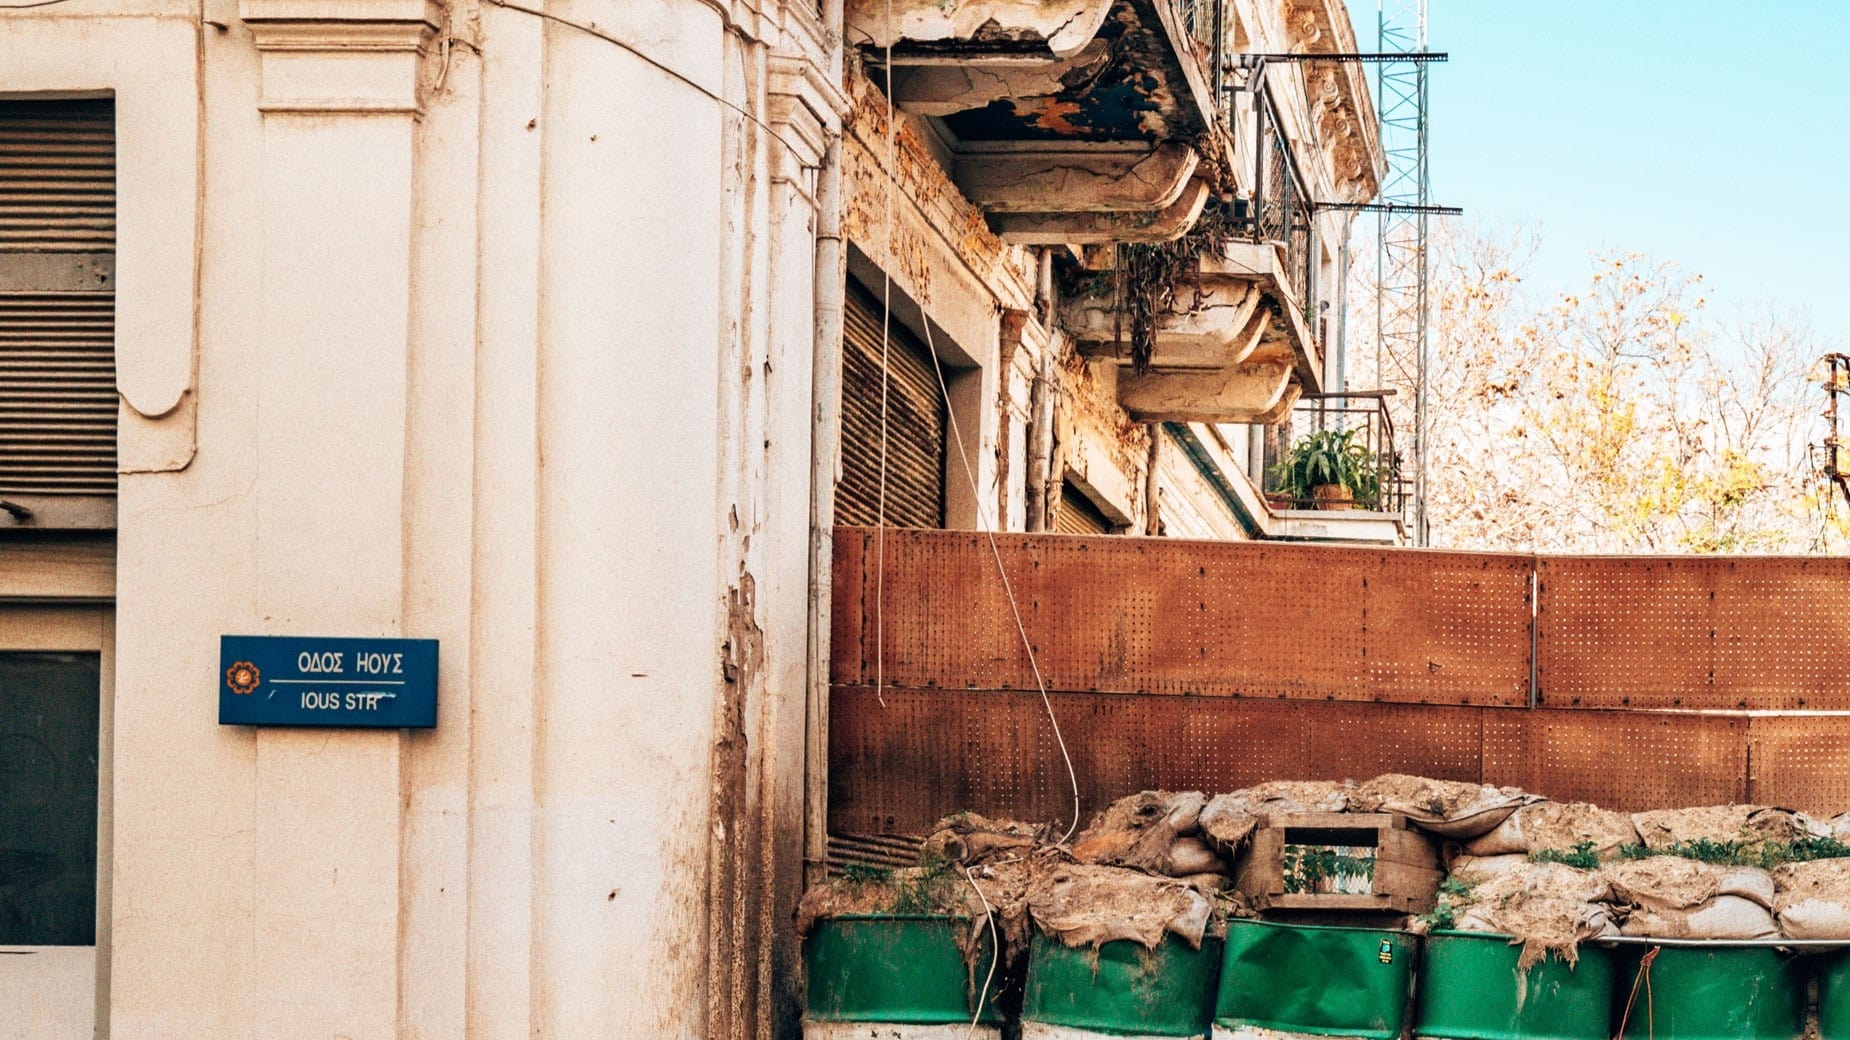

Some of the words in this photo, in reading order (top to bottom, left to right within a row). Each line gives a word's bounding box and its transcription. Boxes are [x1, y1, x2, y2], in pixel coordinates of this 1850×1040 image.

[298, 651, 344, 673] ΟΔΟΣ
[356, 652, 403, 674] ΗΟΥΣ
[301, 691, 340, 709] IOUS
